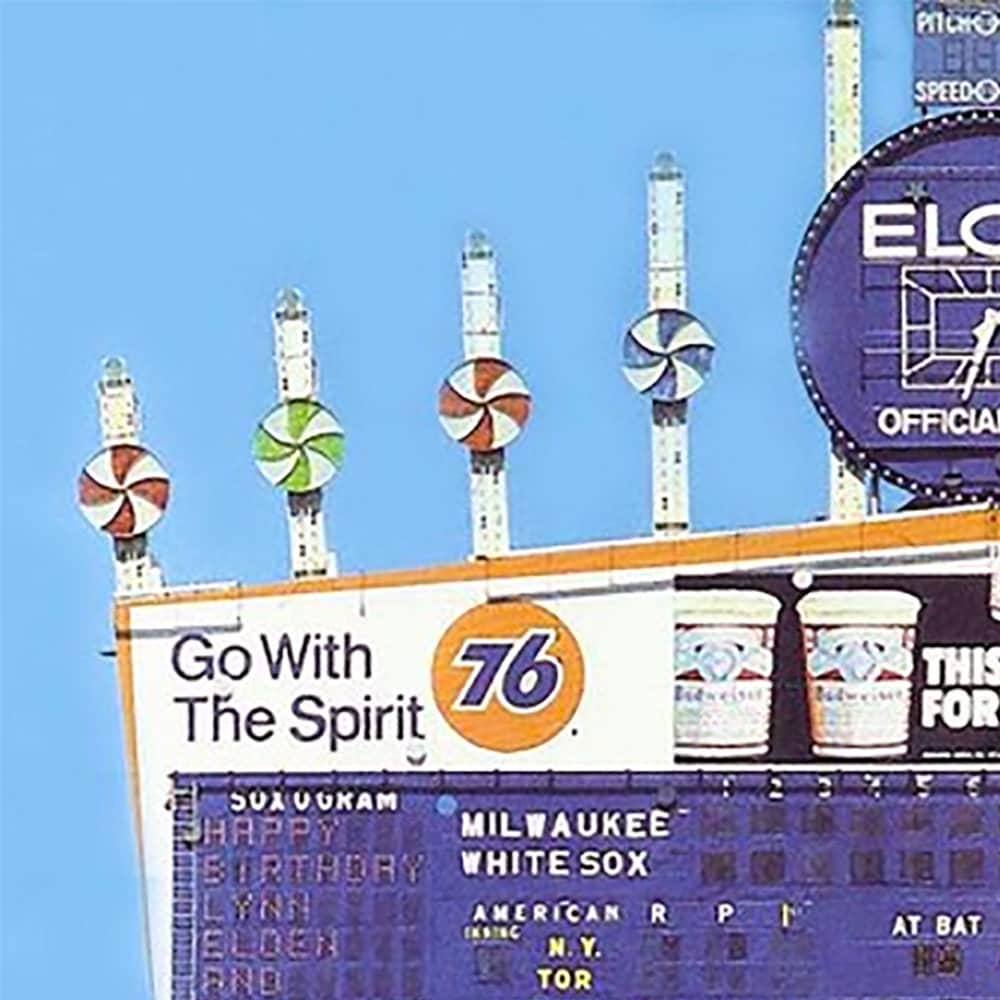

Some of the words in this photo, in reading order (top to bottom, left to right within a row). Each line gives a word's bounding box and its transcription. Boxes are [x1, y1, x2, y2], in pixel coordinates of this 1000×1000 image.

[172, 634, 252, 680] Go
[260, 632, 372, 680] With
[451, 628, 563, 714] 76
[921, 688, 1000, 728] FOR
[173, 693, 277, 743] The
[289, 693, 426, 753] Spirit
[204, 817, 339, 846] HAPPY
[461, 809, 670, 838] MILWAUKEE
[204, 854, 422, 884] BIRTHDAY
[461, 850, 570, 876] WHITE
[580, 850, 647, 876] SOX
[473, 901, 619, 923] AMERICAN
[651, 903, 666, 923] R
[718, 903, 734, 923] P
[892, 915, 921, 936] AT
[936, 915, 981, 936] BAT
[537, 968, 592, 990] TOR
